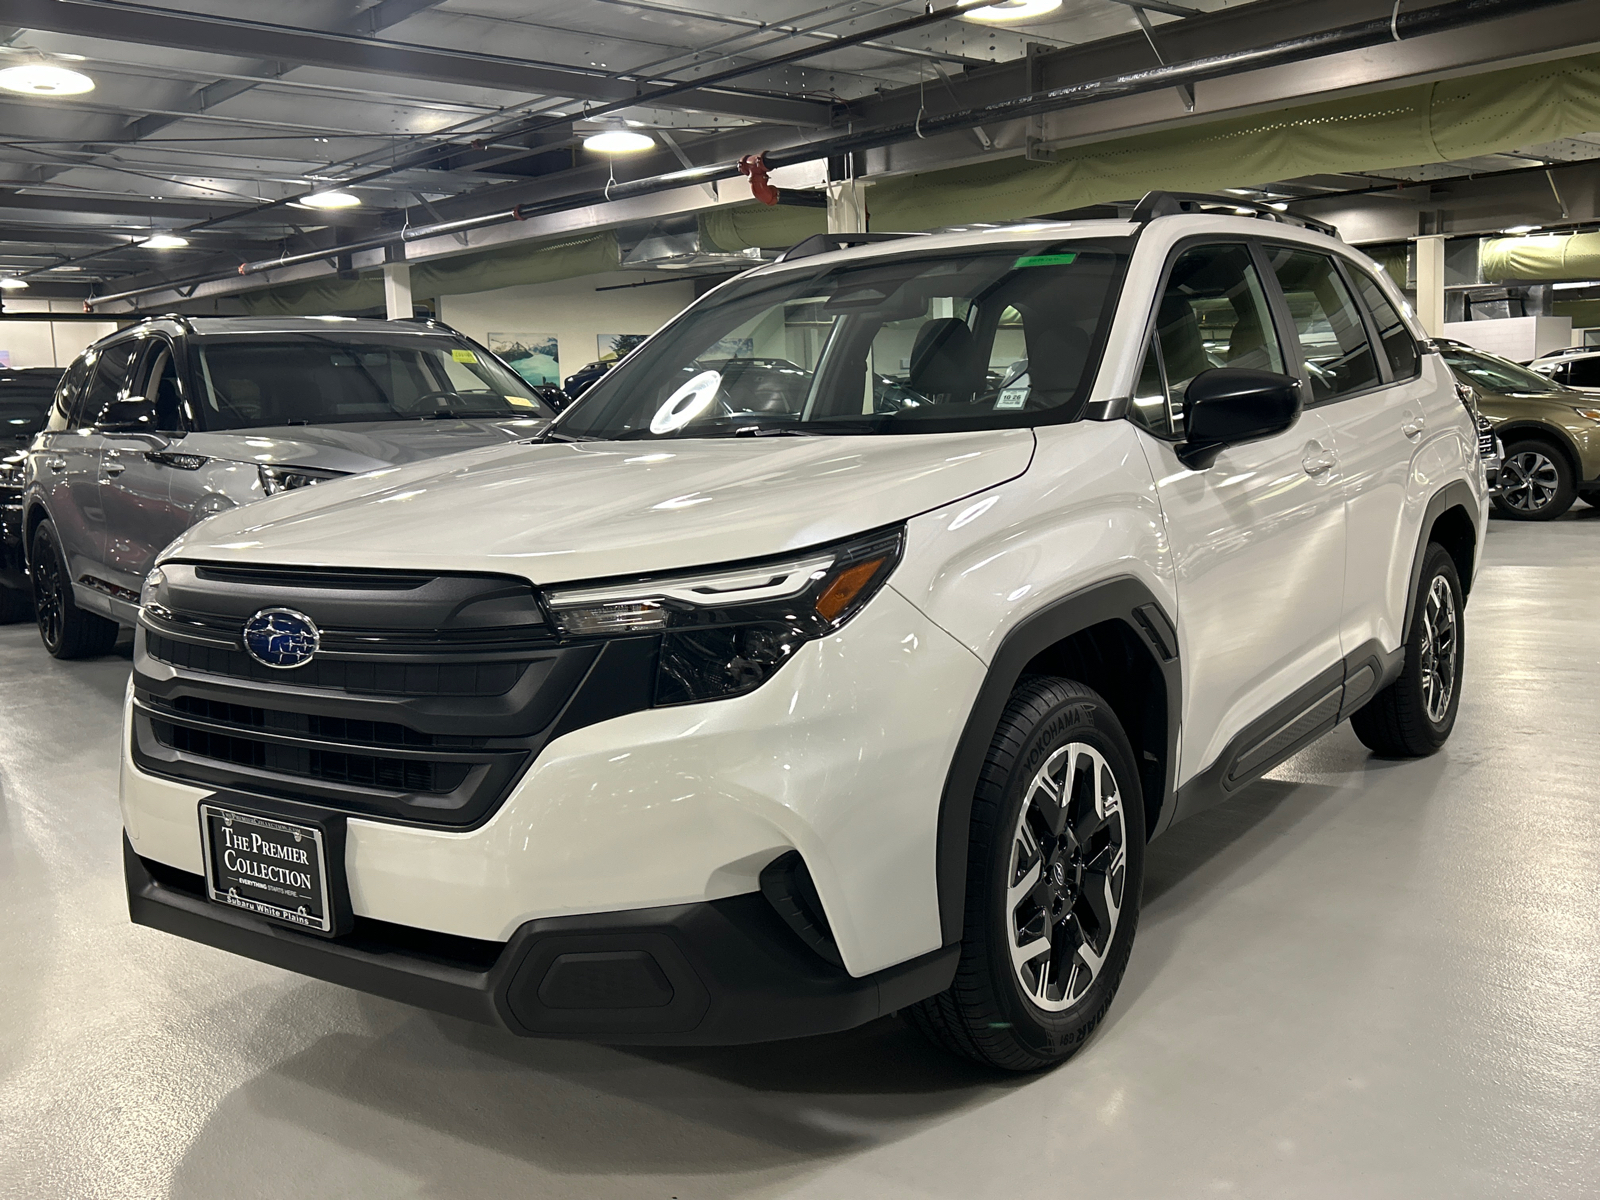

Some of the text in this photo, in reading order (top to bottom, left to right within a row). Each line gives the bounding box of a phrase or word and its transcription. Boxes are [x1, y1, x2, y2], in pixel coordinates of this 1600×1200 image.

[1023, 707, 1081, 773] YOKOHAMA
[221, 826, 309, 865] THE PREMIER
[224, 849, 311, 890] COLLECTION
[238, 877, 267, 890] EVERYTHING
[267, 884, 284, 895] STARTS
[226, 895, 309, 925] Subaru White Plains
[1059, 1032, 1075, 1047] G91
